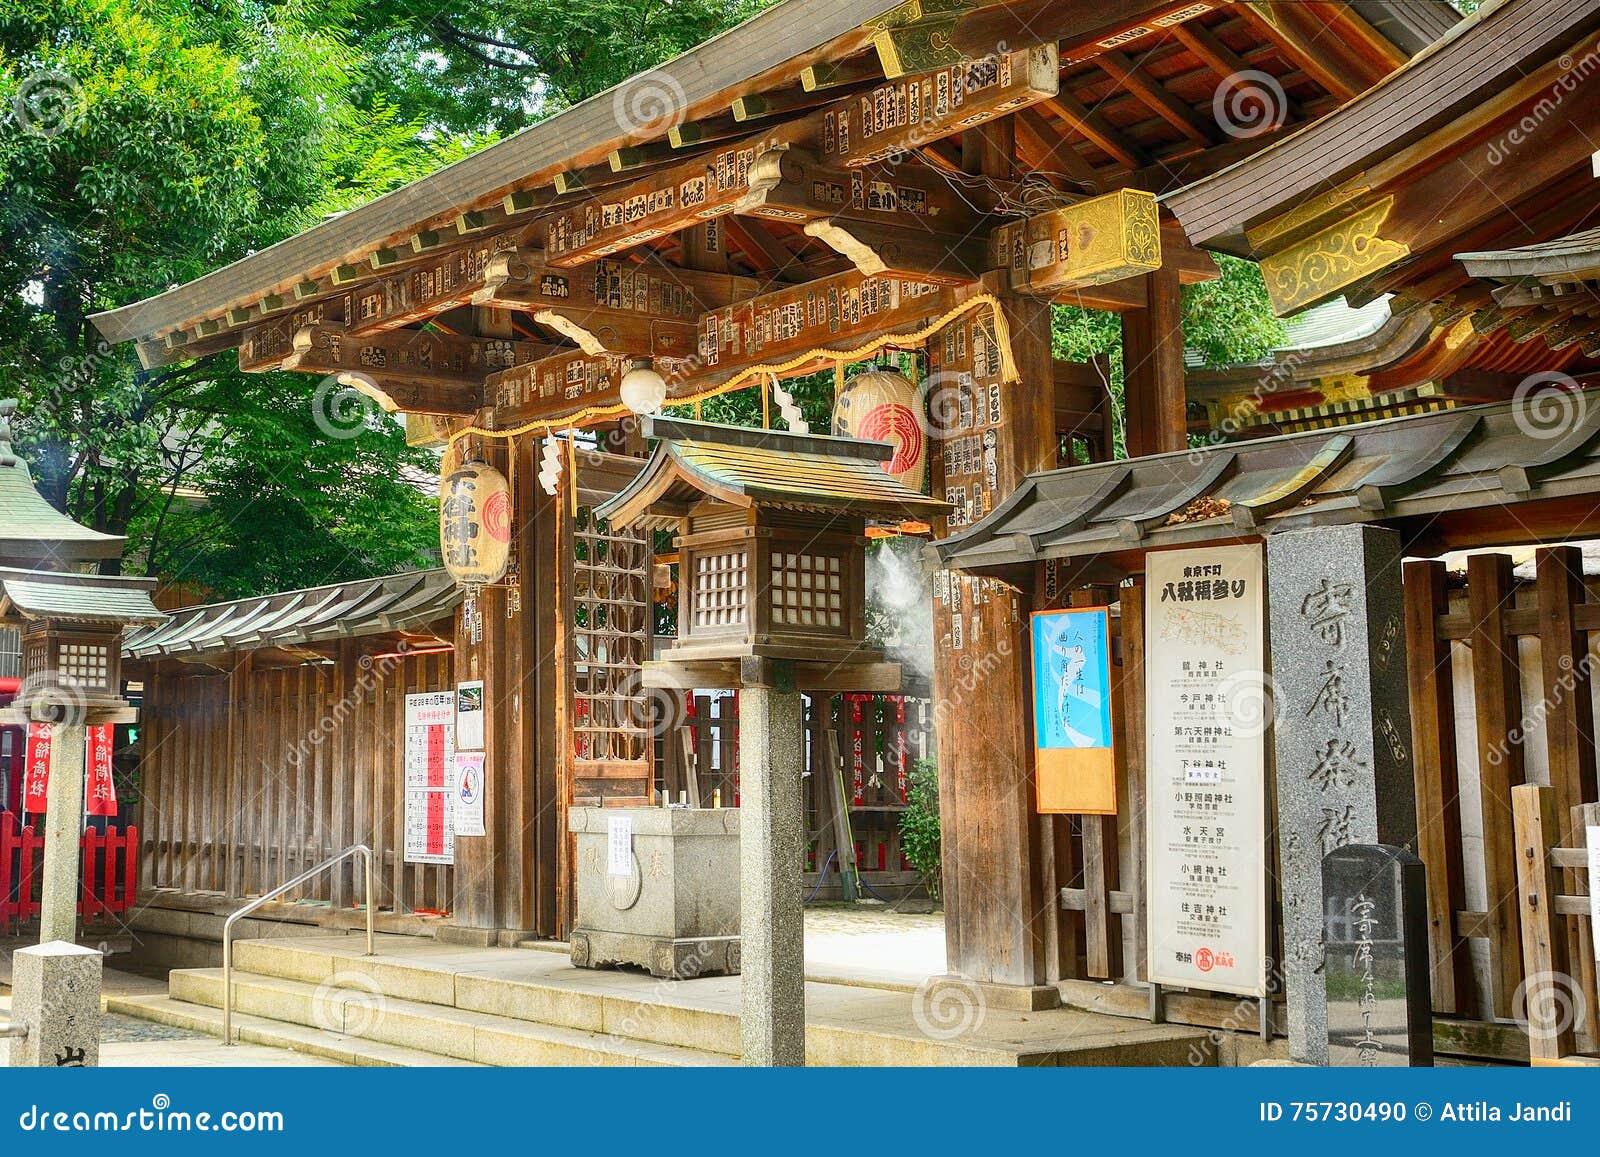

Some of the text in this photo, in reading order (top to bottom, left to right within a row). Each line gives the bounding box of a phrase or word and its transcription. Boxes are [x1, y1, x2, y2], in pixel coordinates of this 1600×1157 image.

[443, 470, 480, 568] 下谷神社
[1183, 564, 1222, 577] 東京下町
[1161, 579, 1246, 602] 八社福参り
[1072, 630, 1086, 696] 人の一生は
[1057, 632, 1071, 728] 曲り角だらけだ
[1180, 693, 1226, 703] 今戸神社
[1174, 726, 1232, 737] 第六天榊神社
[1180, 759, 1227, 770] 下谷神社
[1174, 791, 1233, 804] 小野照崎神社
[1182, 825, 1225, 837] 水天宮
[1181, 863, 1227, 877] 小網神社
[1181, 902, 1227, 916] 住吉神社
[1189, 913, 1218, 923] 交通安全
[1175, 951, 1192, 964] 奉納
